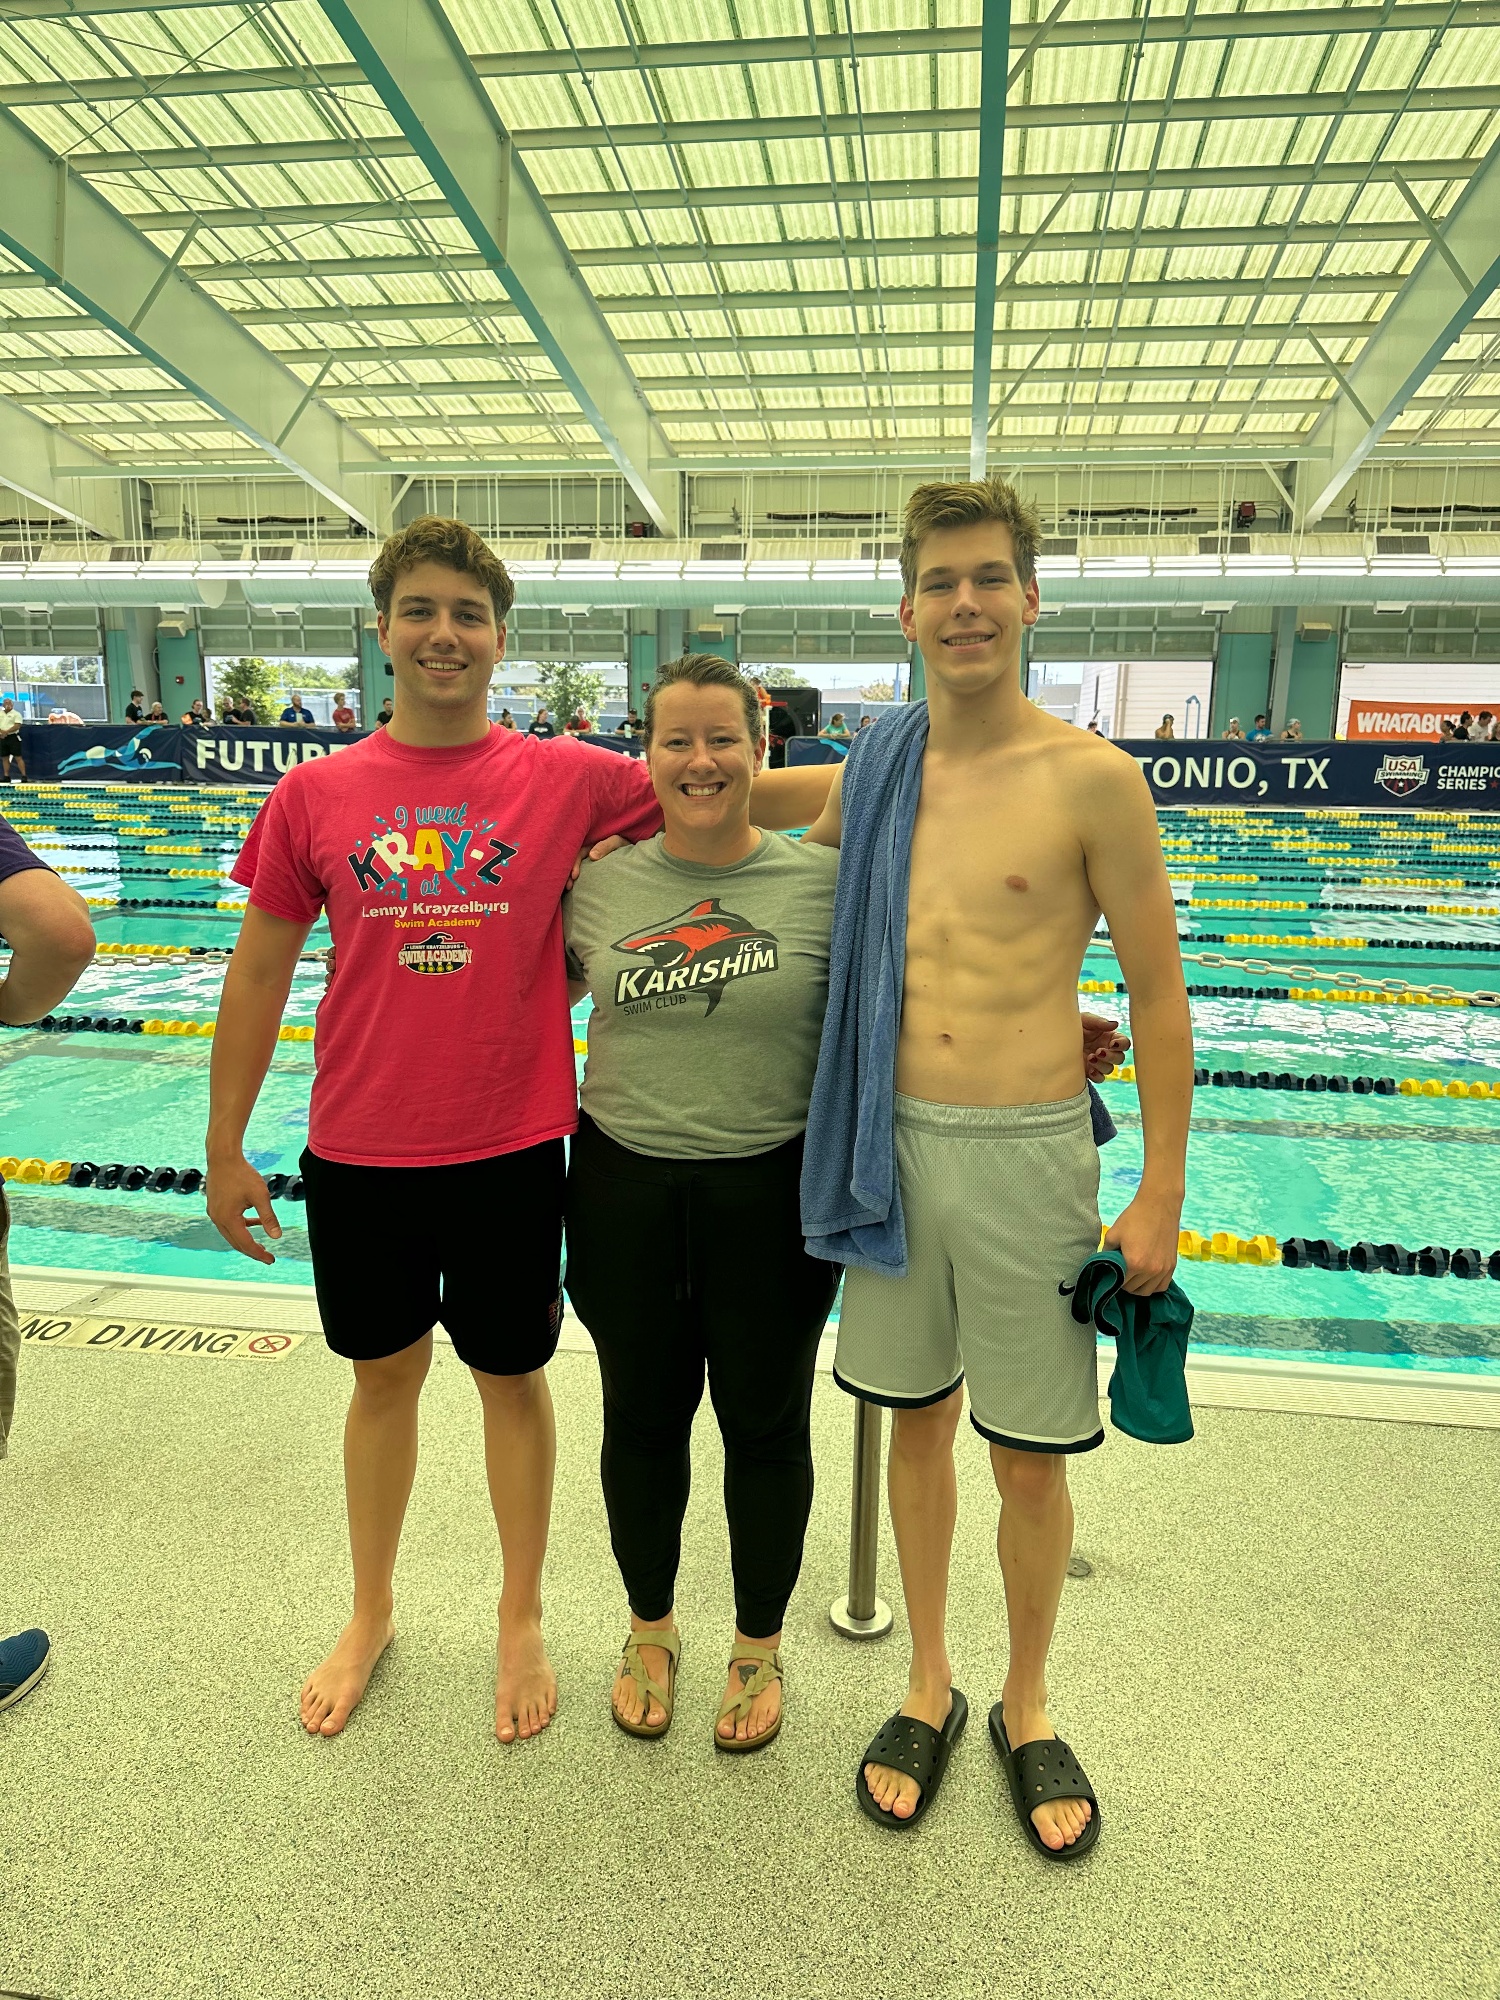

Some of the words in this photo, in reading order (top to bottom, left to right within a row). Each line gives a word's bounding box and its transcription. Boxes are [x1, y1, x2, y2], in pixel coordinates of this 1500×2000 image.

[1281, 757, 1331, 790] TX
[1388, 761, 1417, 772] USA
[1437, 778, 1487, 790] SERIES
[395, 806, 408, 828] I
[415, 802, 468, 827] went
[347, 828, 518, 892] KRAY-Z
[420, 873, 441, 896] at
[362, 905, 408, 918] Lenny
[412, 901, 509, 917] Krayzelburg
[394, 919, 424, 928] Swim
[428, 918, 481, 928] Academy
[398, 950, 426, 965] SWIM
[427, 949, 473, 964] ACADEMY
[738, 941, 763, 954] JCC
[617, 949, 775, 1003] KARISHIM
[623, 1001, 652, 1016] SWIM
[655, 994, 687, 1010] CLUB
[20, 1319, 72, 1340] NO
[87, 1324, 239, 1355] DIVING
